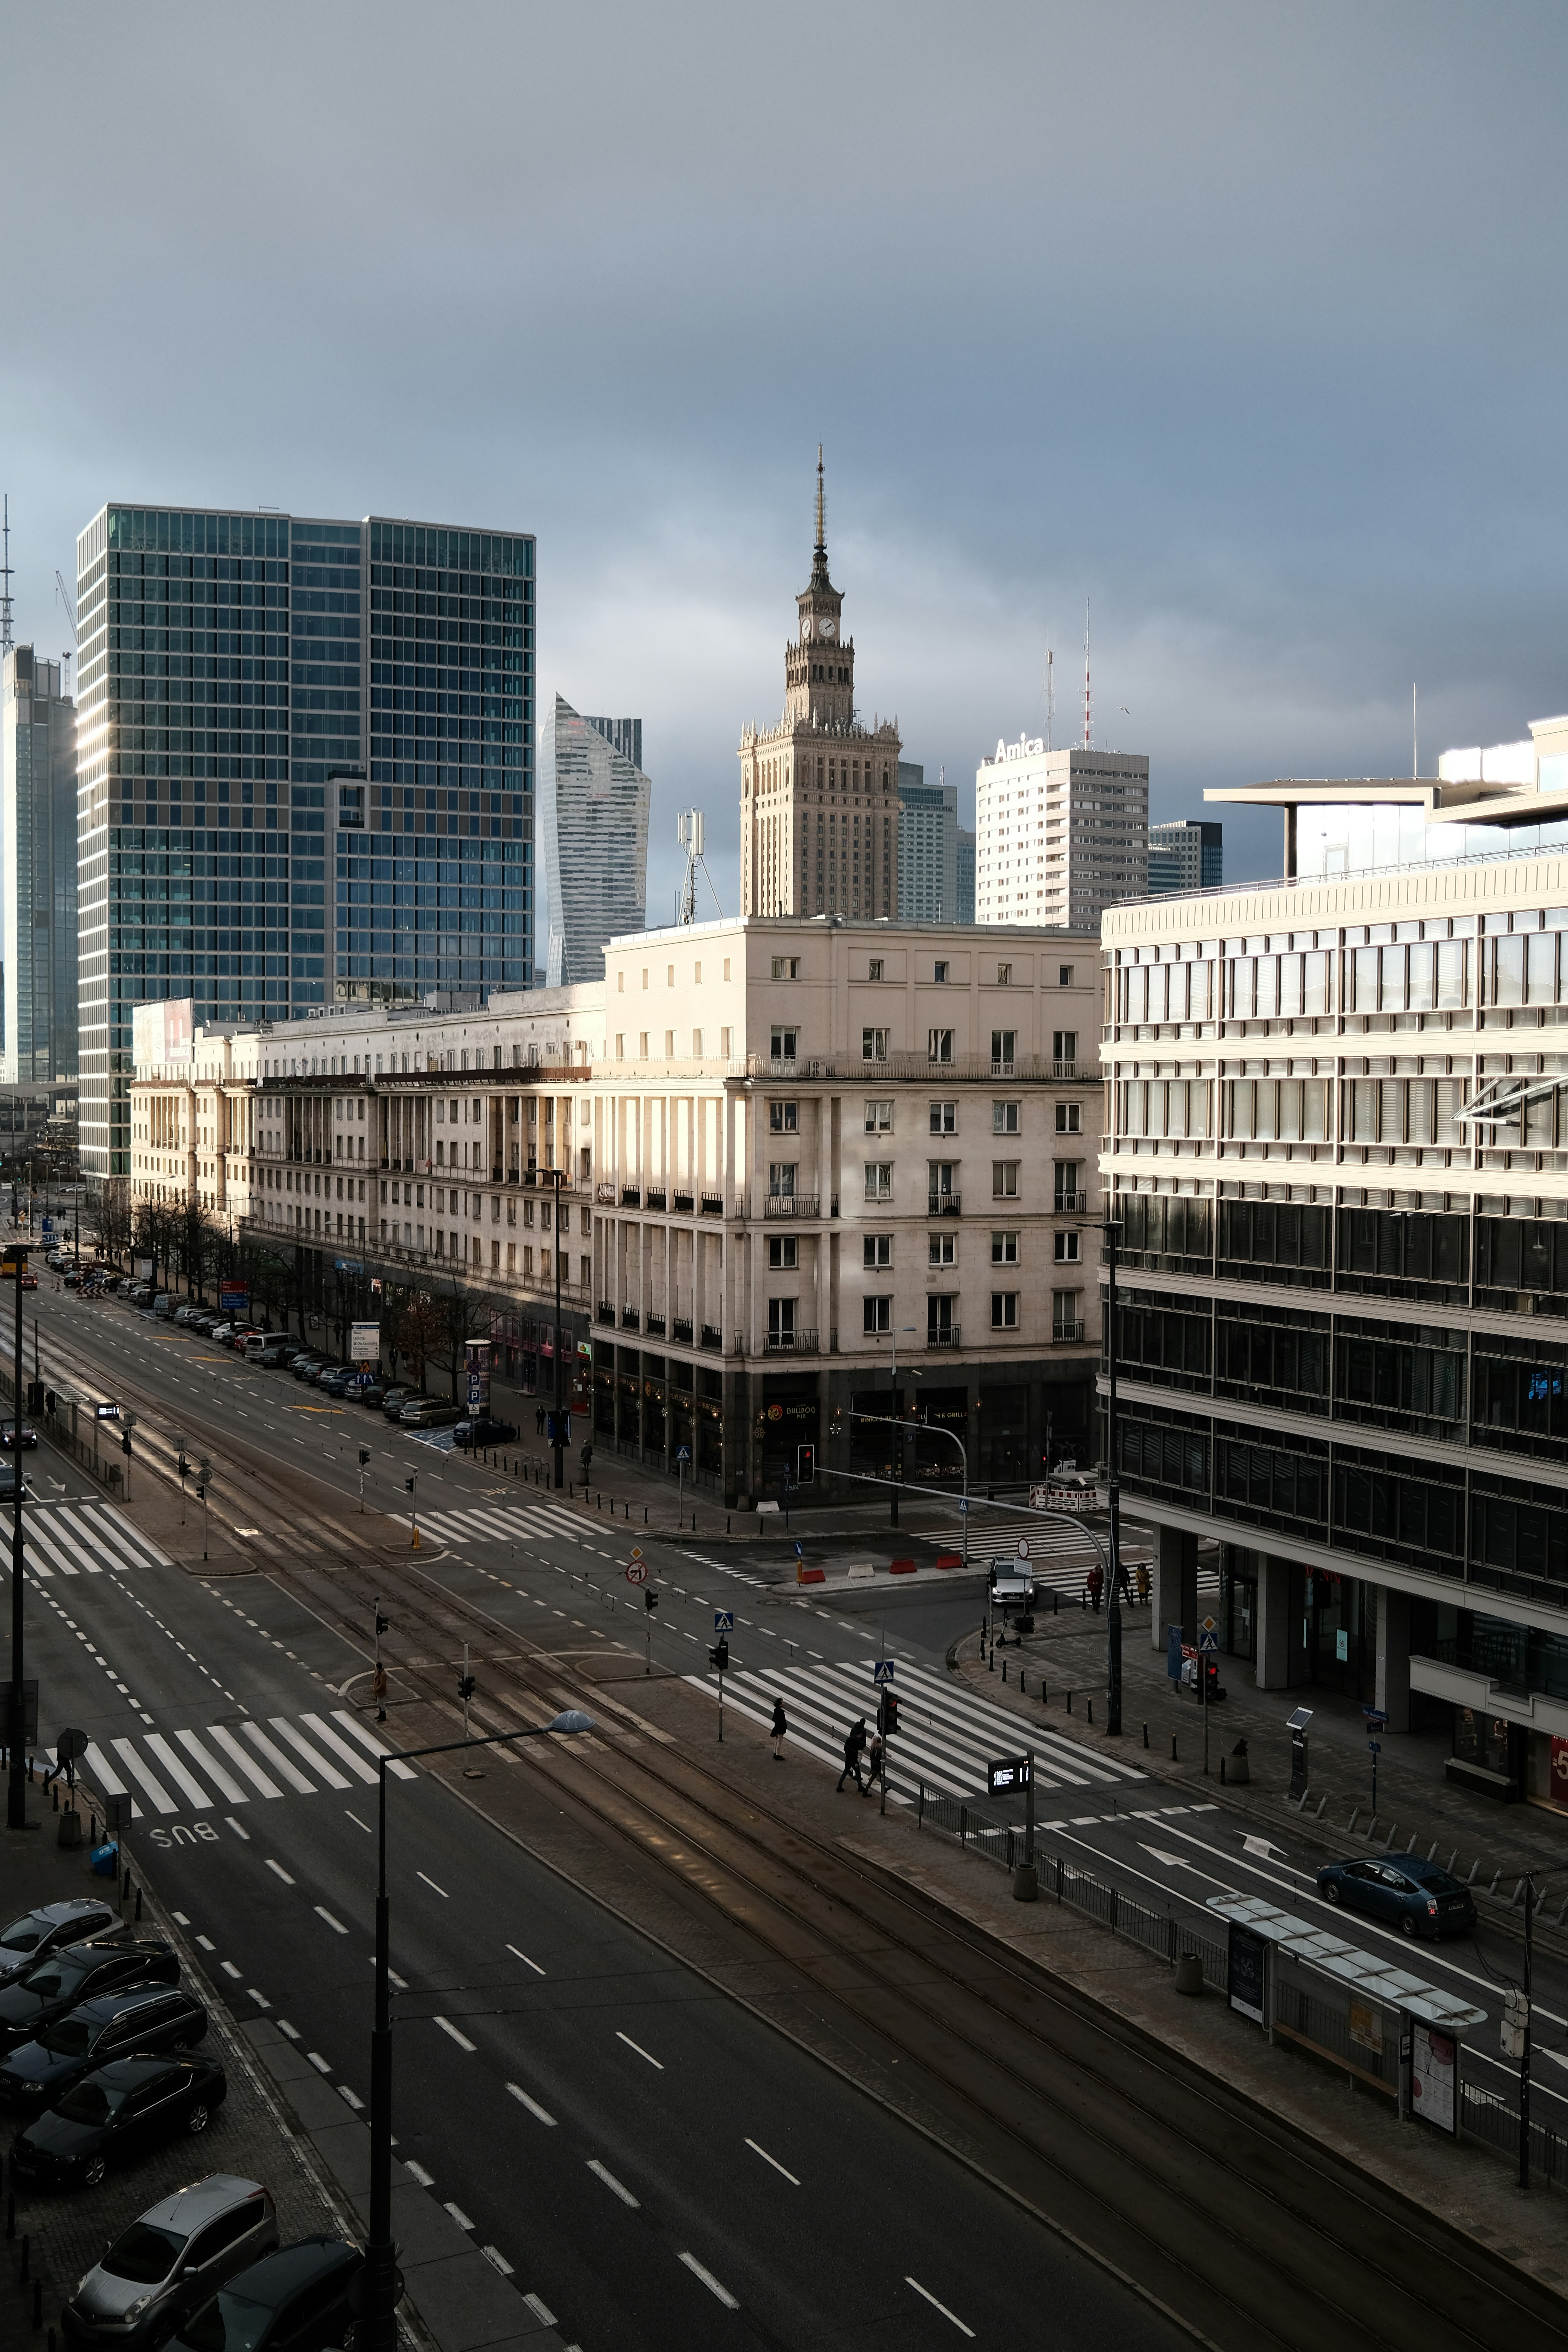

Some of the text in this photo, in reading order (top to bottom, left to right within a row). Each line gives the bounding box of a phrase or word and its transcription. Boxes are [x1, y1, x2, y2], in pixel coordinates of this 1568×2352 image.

[995, 732, 1043, 764] Amica
[906, 803, 953, 812] INTERCONTINENTAL
[787, 1406, 816, 1415] BULLDOG
[149, 1822, 220, 1848] BUS
